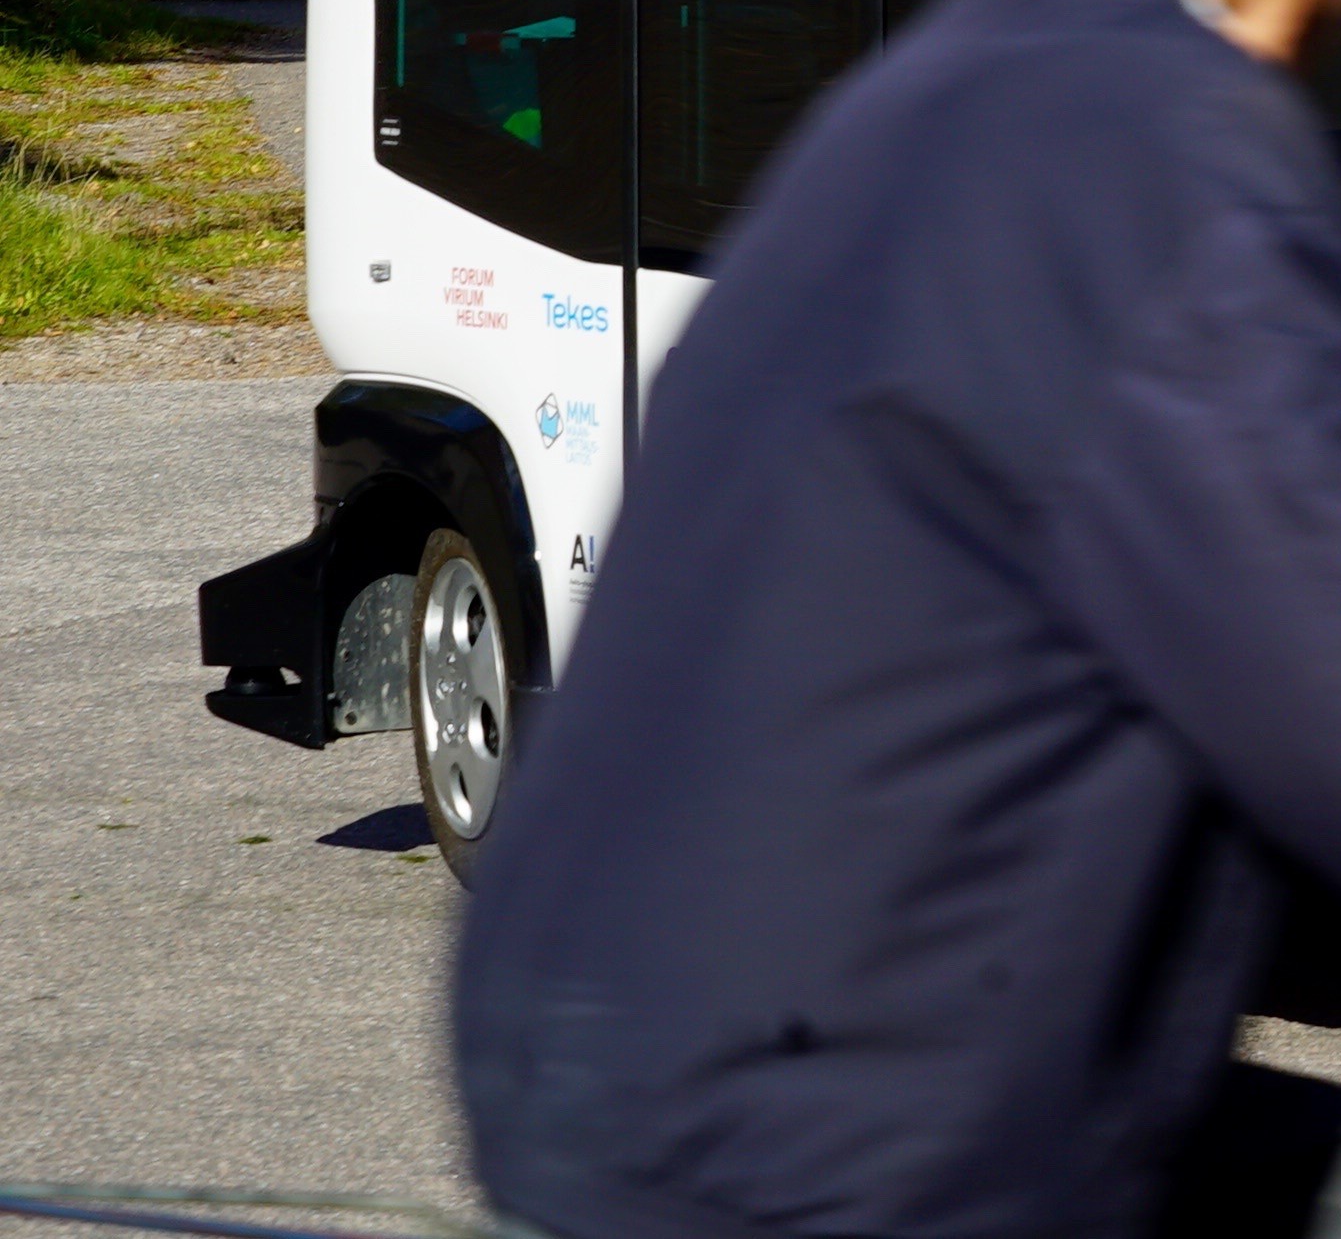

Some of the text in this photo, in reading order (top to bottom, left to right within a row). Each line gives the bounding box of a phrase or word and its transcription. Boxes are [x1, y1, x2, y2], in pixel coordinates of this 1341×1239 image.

[451, 267, 495, 287] FORUM
[443, 287, 484, 307] VIRIUM
[456, 309, 508, 330] HELSINKI
[542, 293, 609, 332] Tekes
[566, 400, 599, 427] MML
[570, 533, 595, 574] A!
